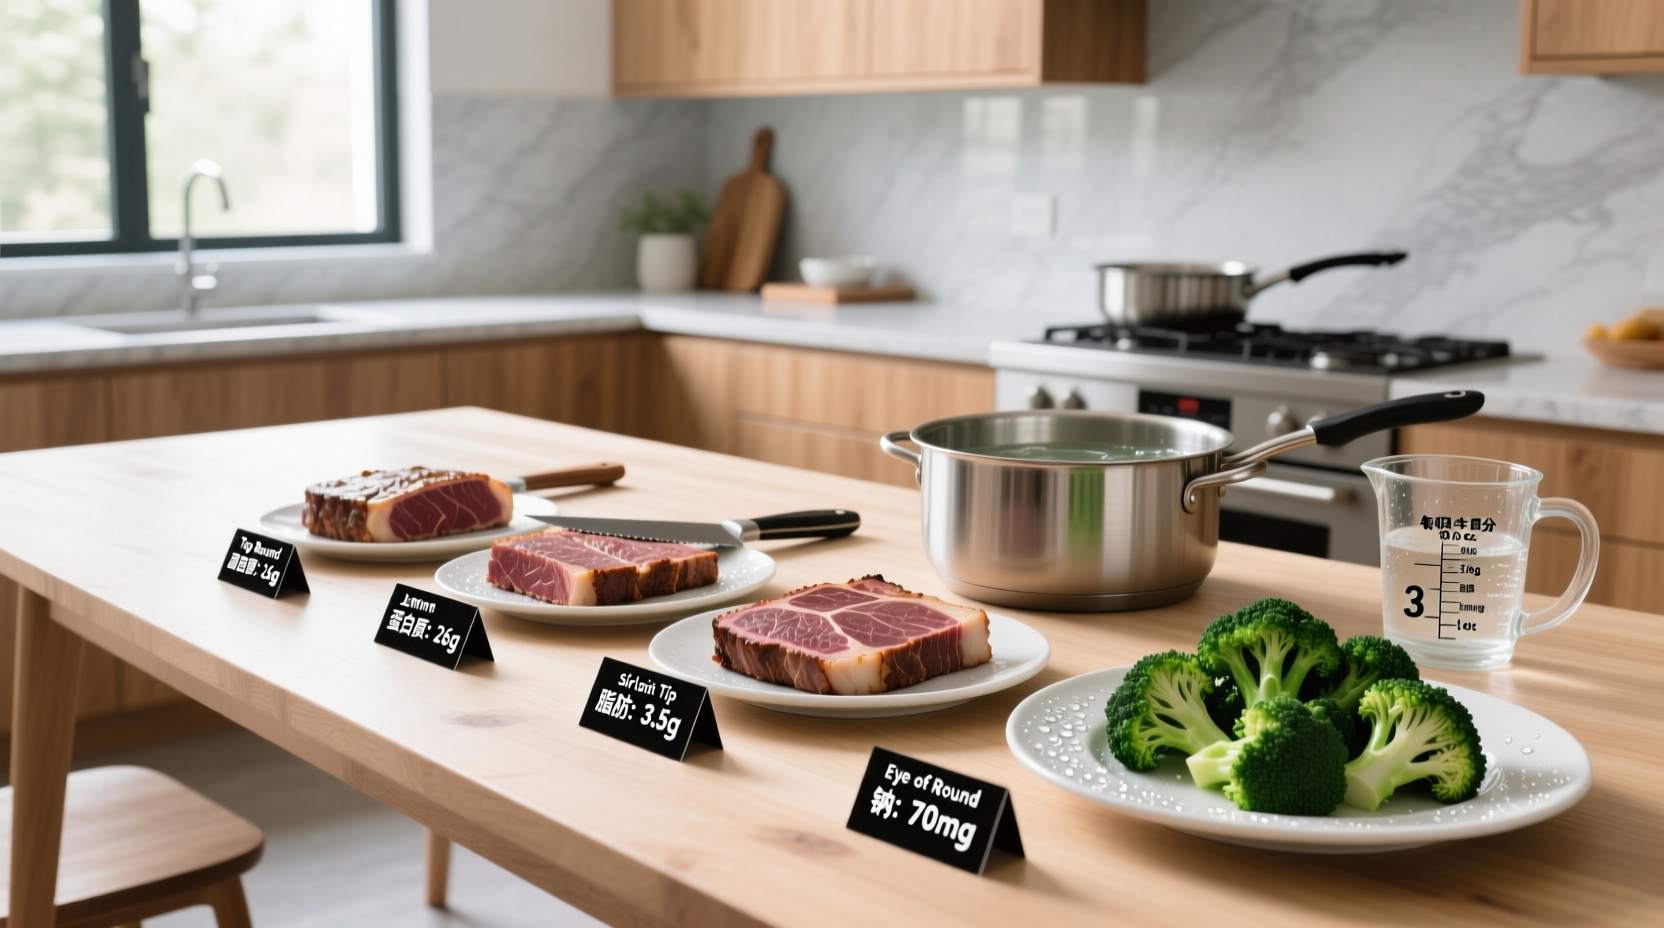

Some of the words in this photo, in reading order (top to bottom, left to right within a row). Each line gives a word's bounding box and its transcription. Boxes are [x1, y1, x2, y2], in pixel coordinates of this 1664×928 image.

[1403, 585, 1424, 618] 3
[432, 625, 460, 654] 26g
[659, 684, 677, 705] Tip
[640, 703, 682, 741] 3.5g
[884, 763, 911, 786] Eye
[913, 774, 933, 790] of
[931, 777, 983, 809] Round
[907, 799, 977, 852] 70mg
